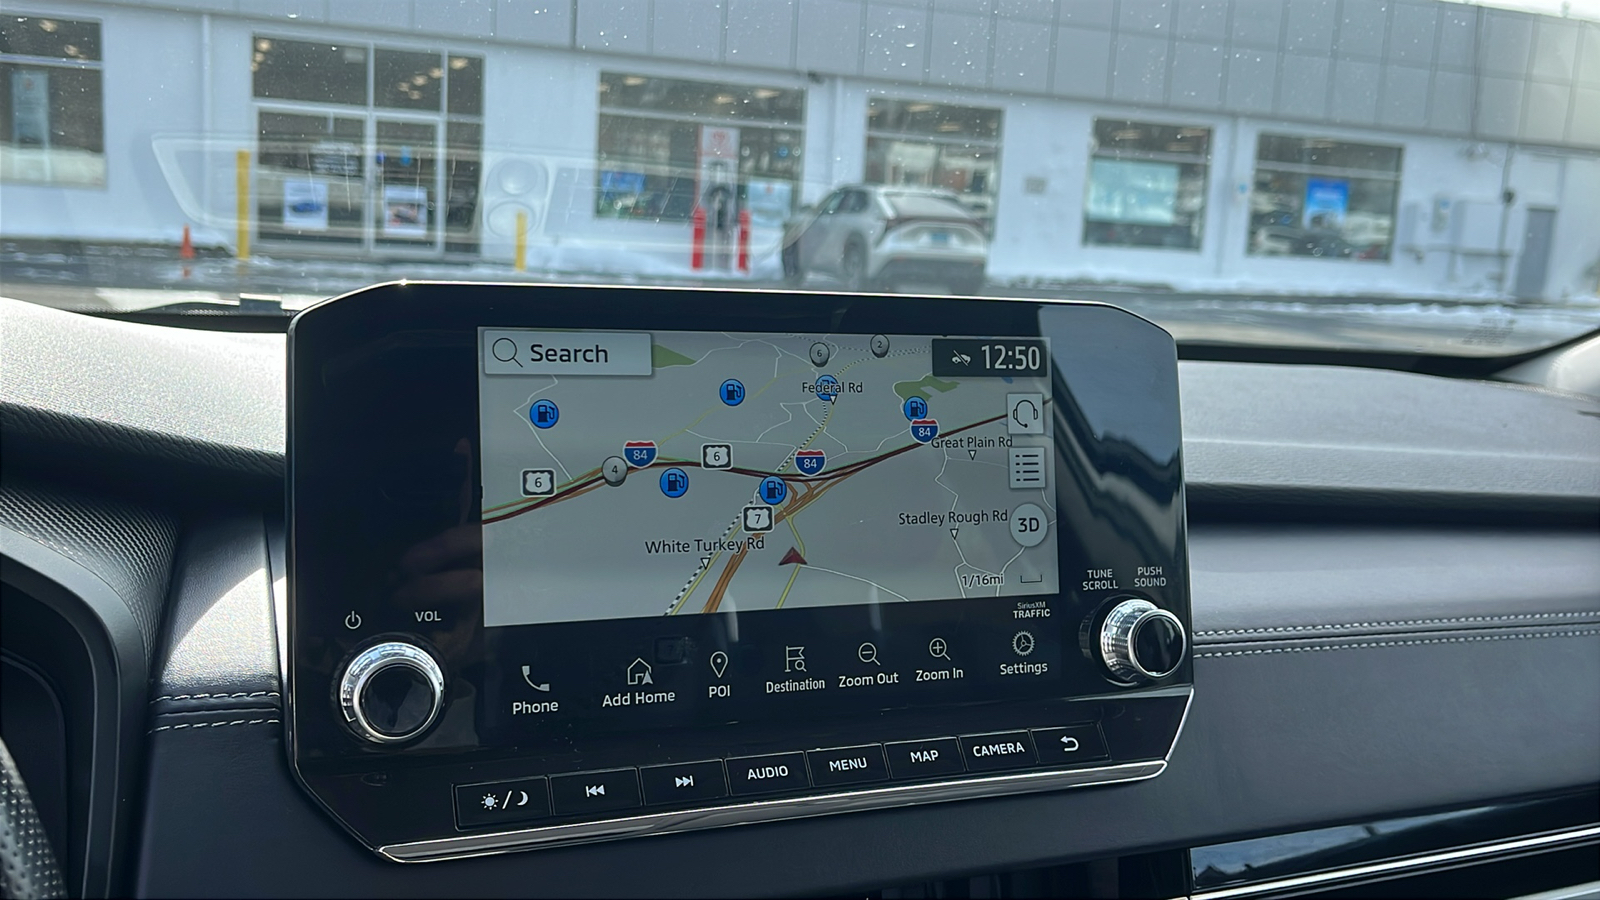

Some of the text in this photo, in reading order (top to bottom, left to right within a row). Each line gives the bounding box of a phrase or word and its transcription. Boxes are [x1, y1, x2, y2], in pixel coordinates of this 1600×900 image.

[877, 340, 883, 349] 2
[530, 343, 609, 363] Search
[816, 349, 823, 358] 6
[981, 344, 1041, 371] 12:50
[801, 381, 863, 394] Federal Rd
[918, 426, 931, 437] 84
[931, 436, 1013, 450] Great Plain Rd
[633, 449, 648, 461] 84
[713, 450, 721, 462] 6
[803, 457, 818, 469] 84
[611, 464, 619, 476] 4
[534, 476, 542, 489] 6
[754, 513, 761, 525] 7
[898, 509, 1008, 527] Stadley Rough Rd
[1017, 517, 1040, 532] 3D
[645, 537, 765, 554] White Turkey Rd
[1087, 569, 1113, 579] TUNE
[1137, 567, 1163, 577] PUSH
[962, 572, 1004, 588] 1/16mi
[1082, 580, 1119, 592] SCROLL
[1134, 577, 1167, 588] SOUND
[1017, 601, 1046, 609] SiriusXM
[415, 610, 442, 623] VOL
[1013, 608, 1051, 619] TRAFFIC
[915, 667, 964, 682] Zoom In
[1000, 661, 1048, 676] Settings
[765, 678, 826, 694] Destination
[838, 671, 899, 688] Zoom Out
[708, 684, 731, 698] POI
[602, 690, 676, 708] Add Home
[512, 700, 559, 715] Phone
[972, 741, 1025, 758] CAMERA
[910, 750, 939, 763] MAP
[829, 757, 868, 773] MENU
[747, 764, 789, 780] AUDIO
